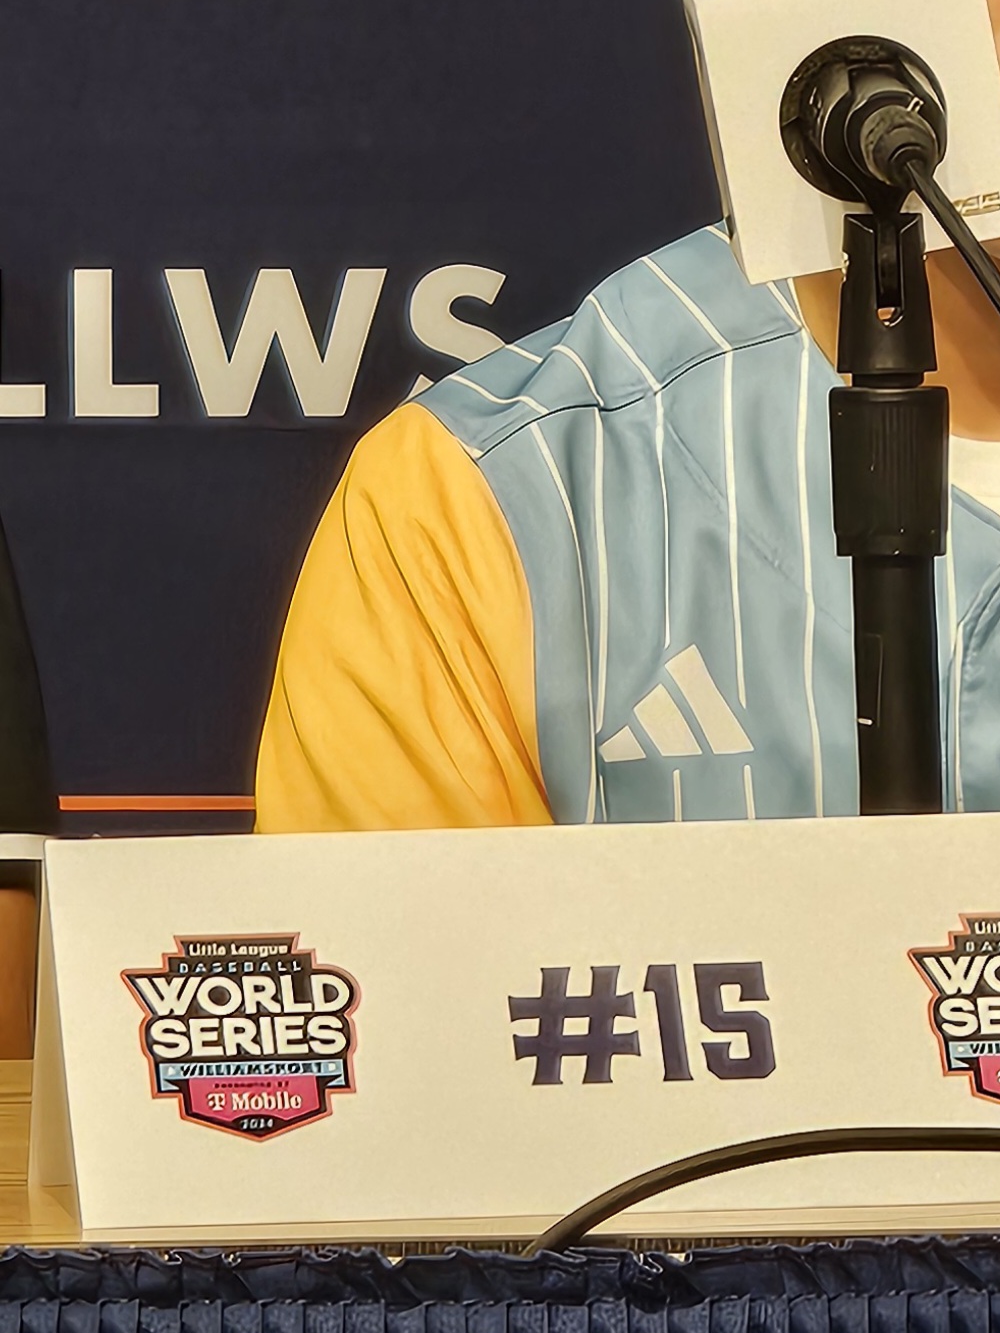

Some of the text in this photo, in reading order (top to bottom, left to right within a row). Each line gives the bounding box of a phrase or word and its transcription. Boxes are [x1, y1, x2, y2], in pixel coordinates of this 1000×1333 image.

[179, 960, 302, 974] BASEBALL
[135, 974, 350, 1017] WORLD
[150, 1015, 347, 1059] SERIES
[508, 962, 776, 1085] #15
[231, 1091, 302, 1111] Mobile
